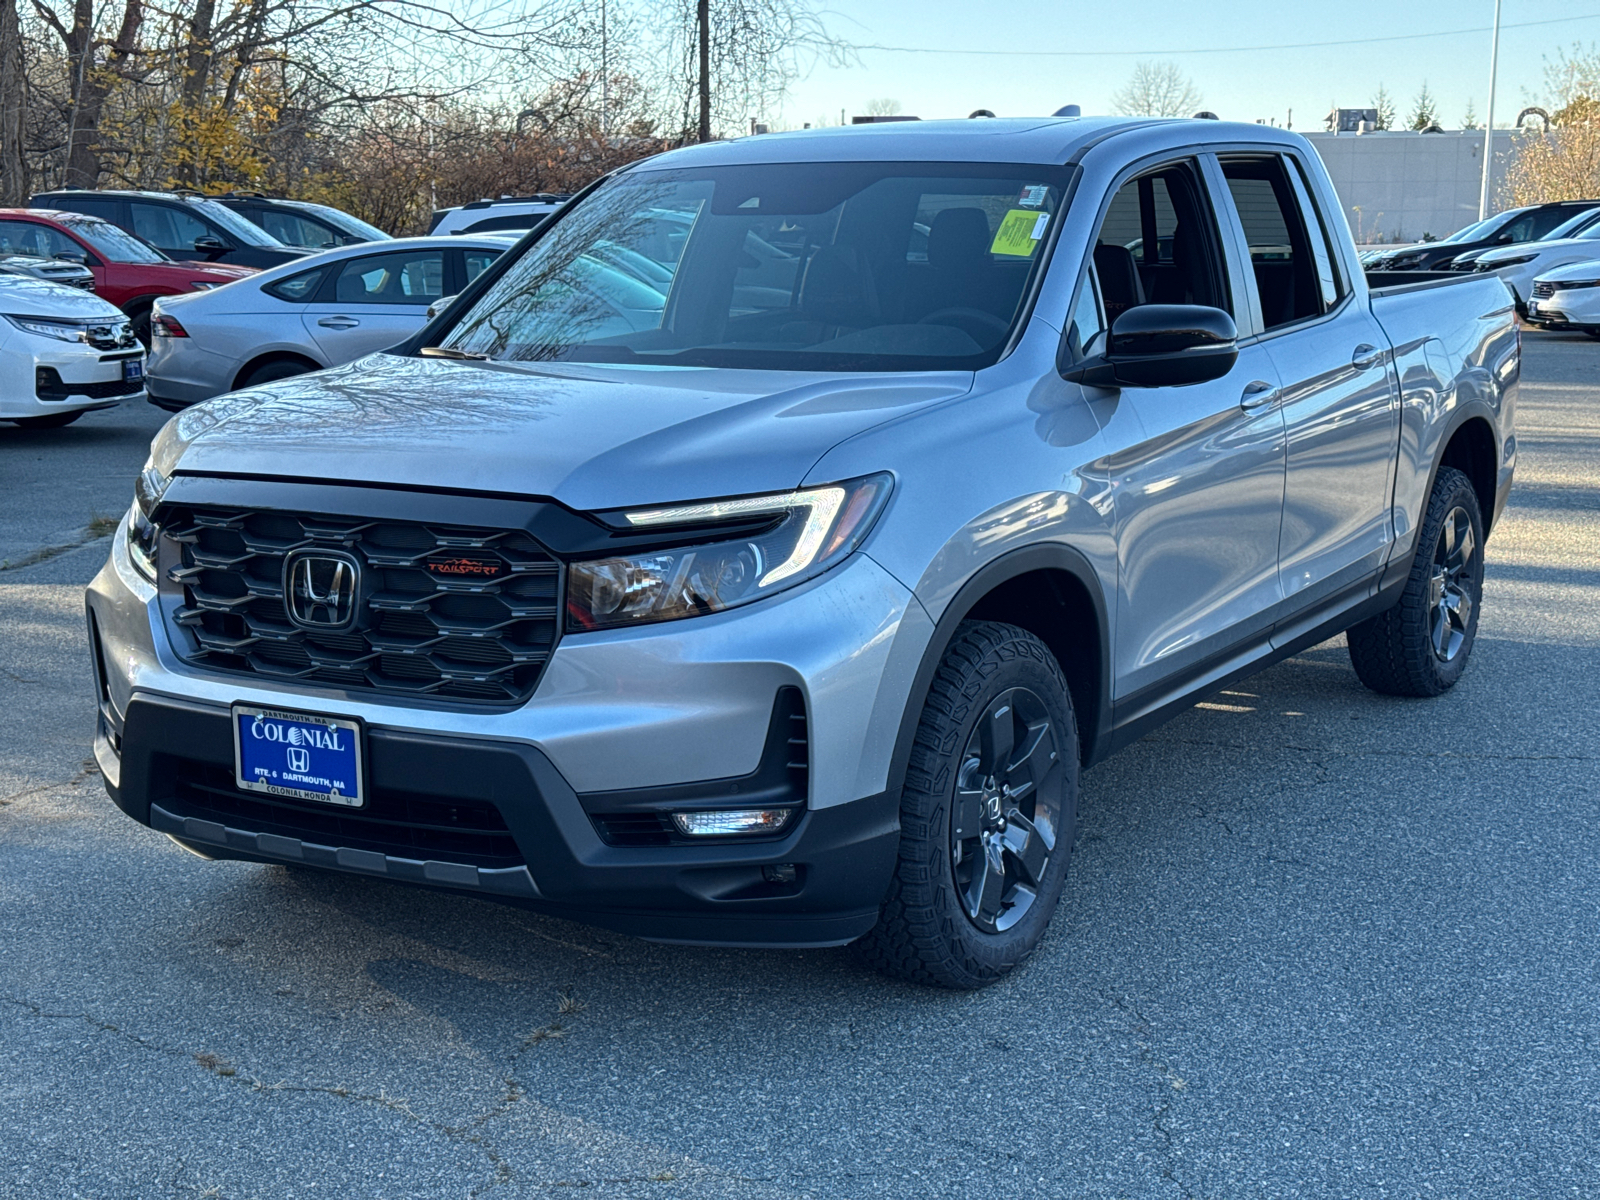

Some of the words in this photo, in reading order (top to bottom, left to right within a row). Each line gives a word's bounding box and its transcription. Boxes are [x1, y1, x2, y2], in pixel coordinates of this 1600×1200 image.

[428, 563, 499, 575] TRAILSPORT
[251, 721, 345, 751] COLONIAL
[254, 767, 271, 777] RTE.
[271, 770, 278, 778] 6
[282, 772, 332, 788] DARTMOUTH,
[333, 780, 345, 789] MA
[266, 785, 302, 798] COLONIAL
[304, 789, 332, 801] HONDA
